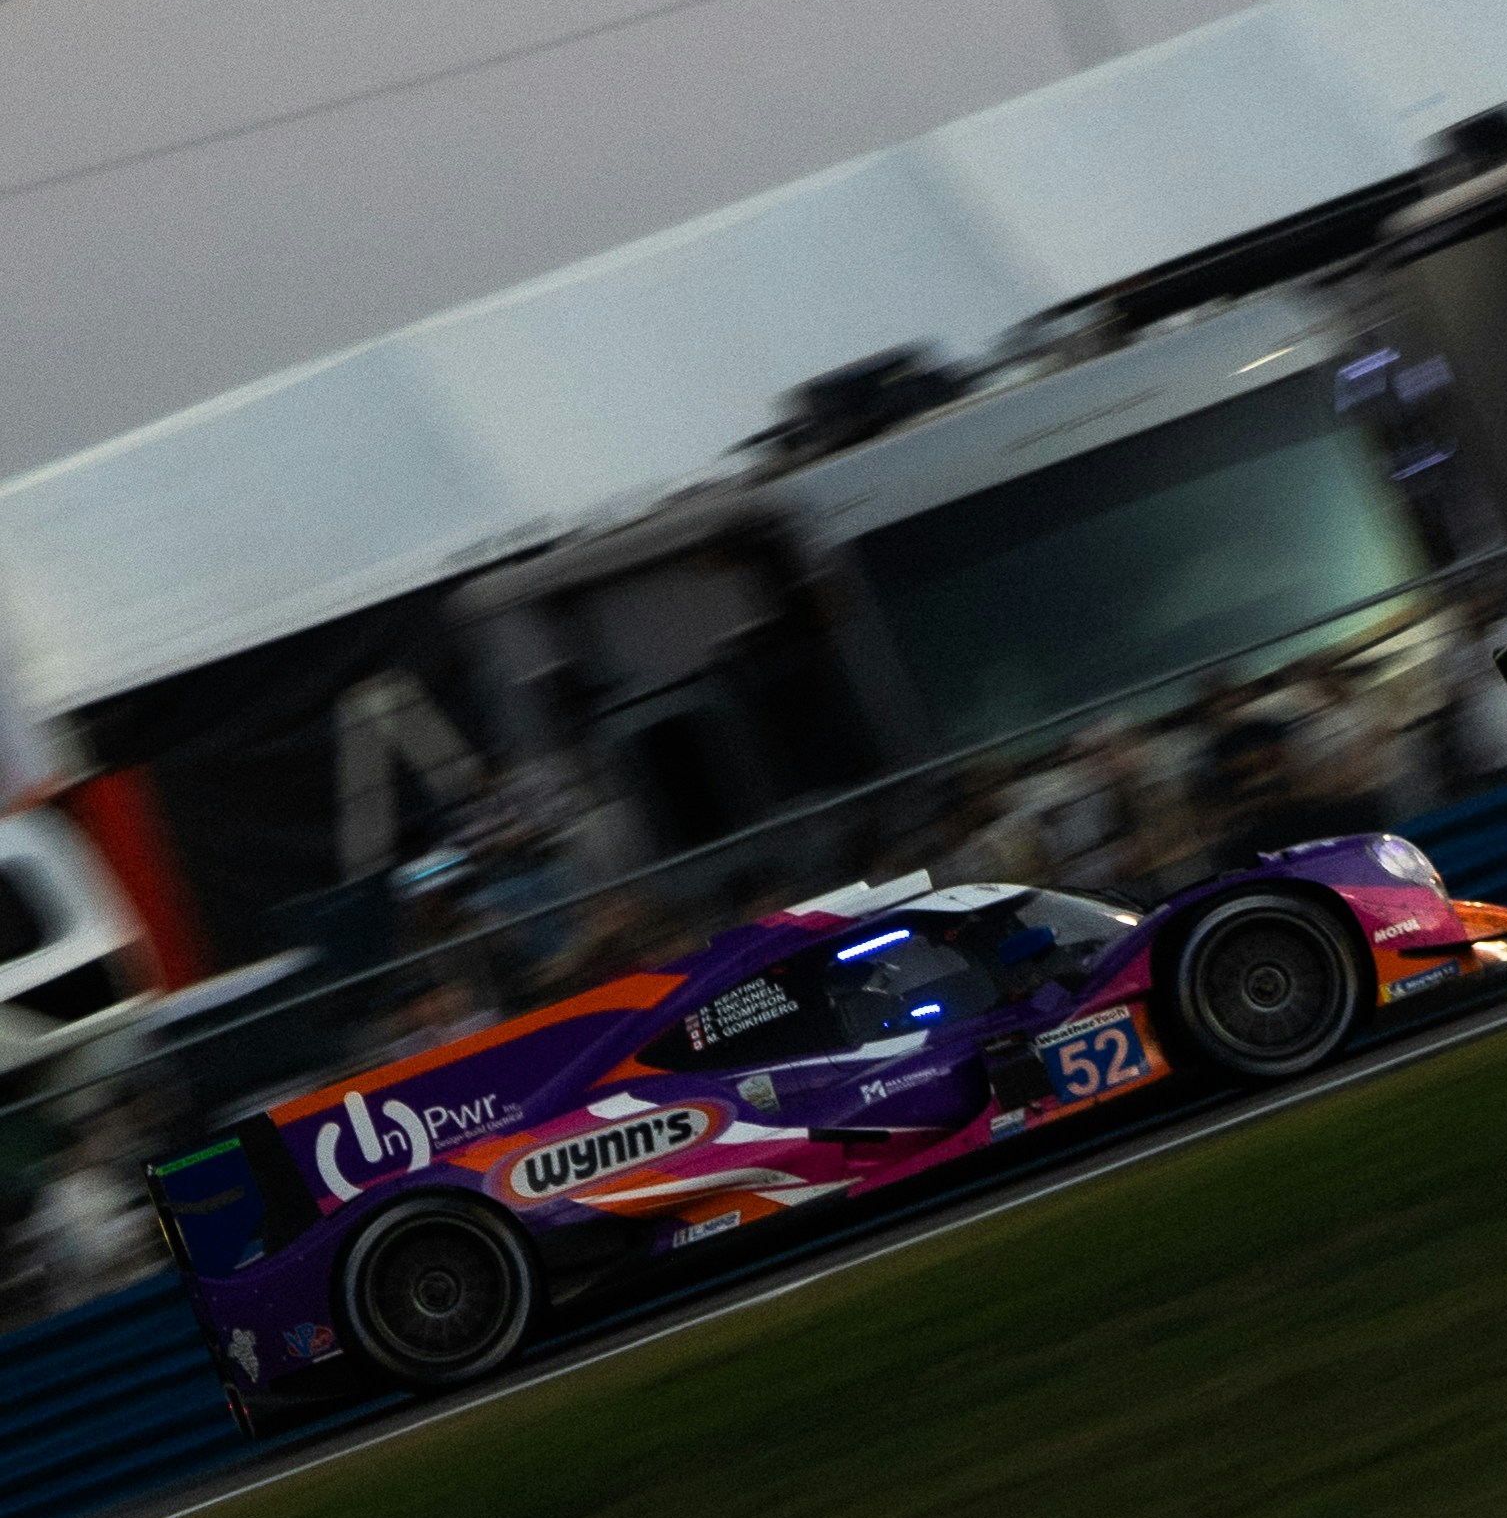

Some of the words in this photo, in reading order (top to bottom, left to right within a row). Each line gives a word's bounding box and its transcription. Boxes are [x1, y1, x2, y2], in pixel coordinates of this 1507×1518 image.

[1373, 918, 1421, 944] MOTUL
[713, 977, 766, 1006] KEATING
[715, 983, 783, 1017] TINCKNELL
[716, 992, 786, 1028] THOMPSON
[1059, 1027, 1140, 1096] 52
[525, 1112, 693, 1194] wynn's
